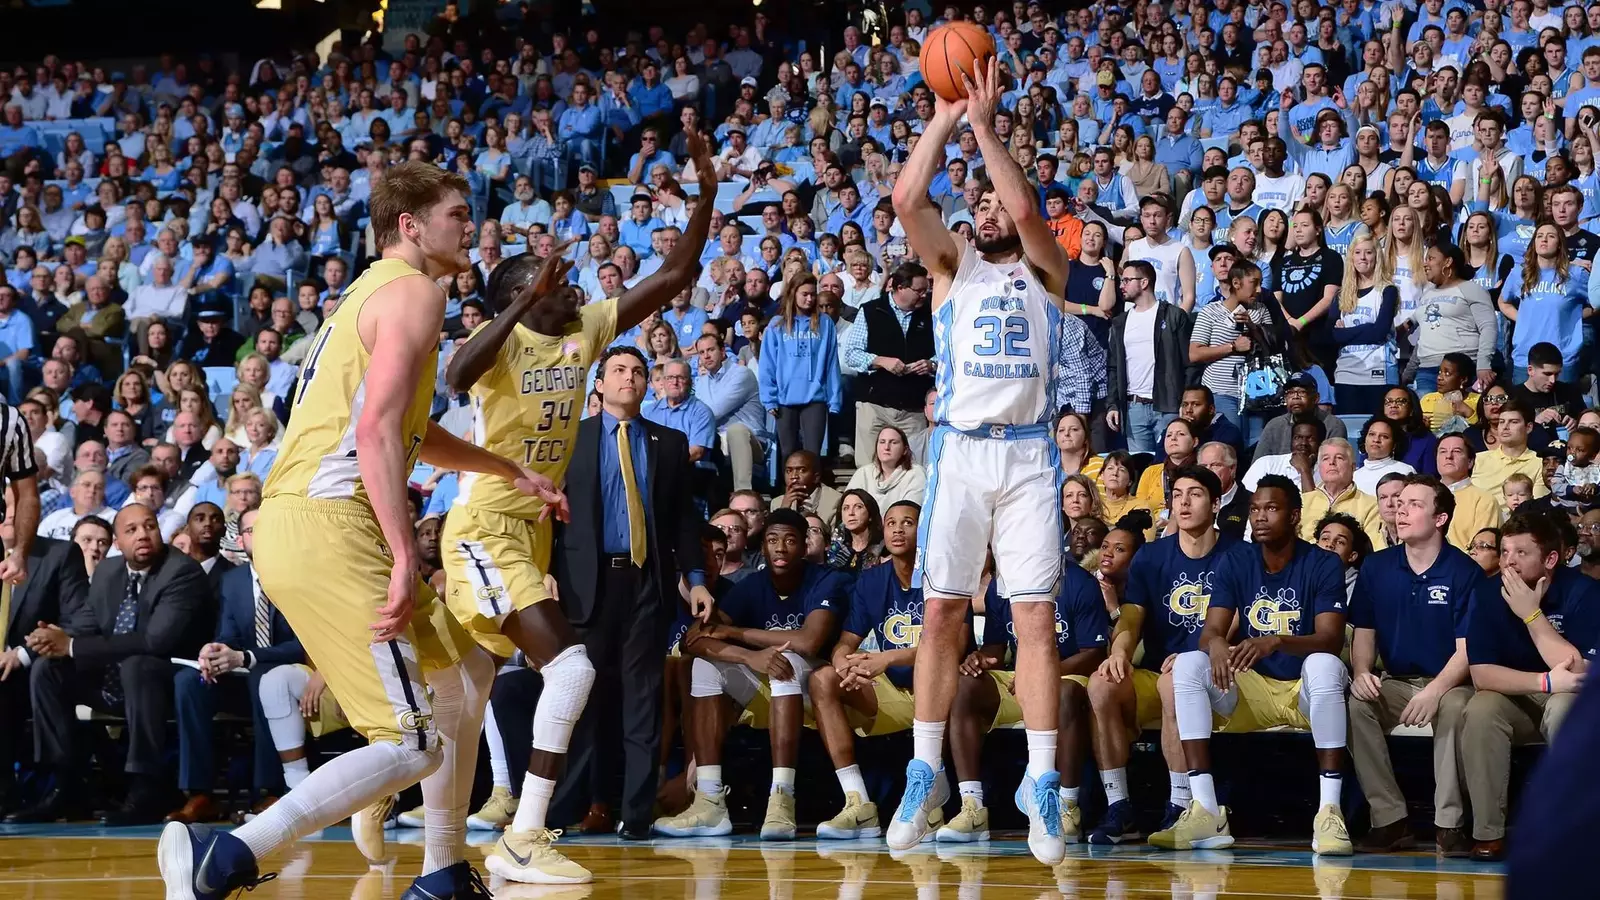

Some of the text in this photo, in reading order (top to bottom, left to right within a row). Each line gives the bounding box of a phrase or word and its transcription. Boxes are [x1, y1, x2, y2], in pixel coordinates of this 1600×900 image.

[979, 295, 1026, 313] NORTH
[972, 315, 1031, 357] 32
[519, 364, 586, 396] GEORGIA
[963, 360, 1040, 379] CAROLINA
[535, 397, 575, 432] 34
[1248, 598, 1301, 637] GT
[400, 710, 433, 731] GT
